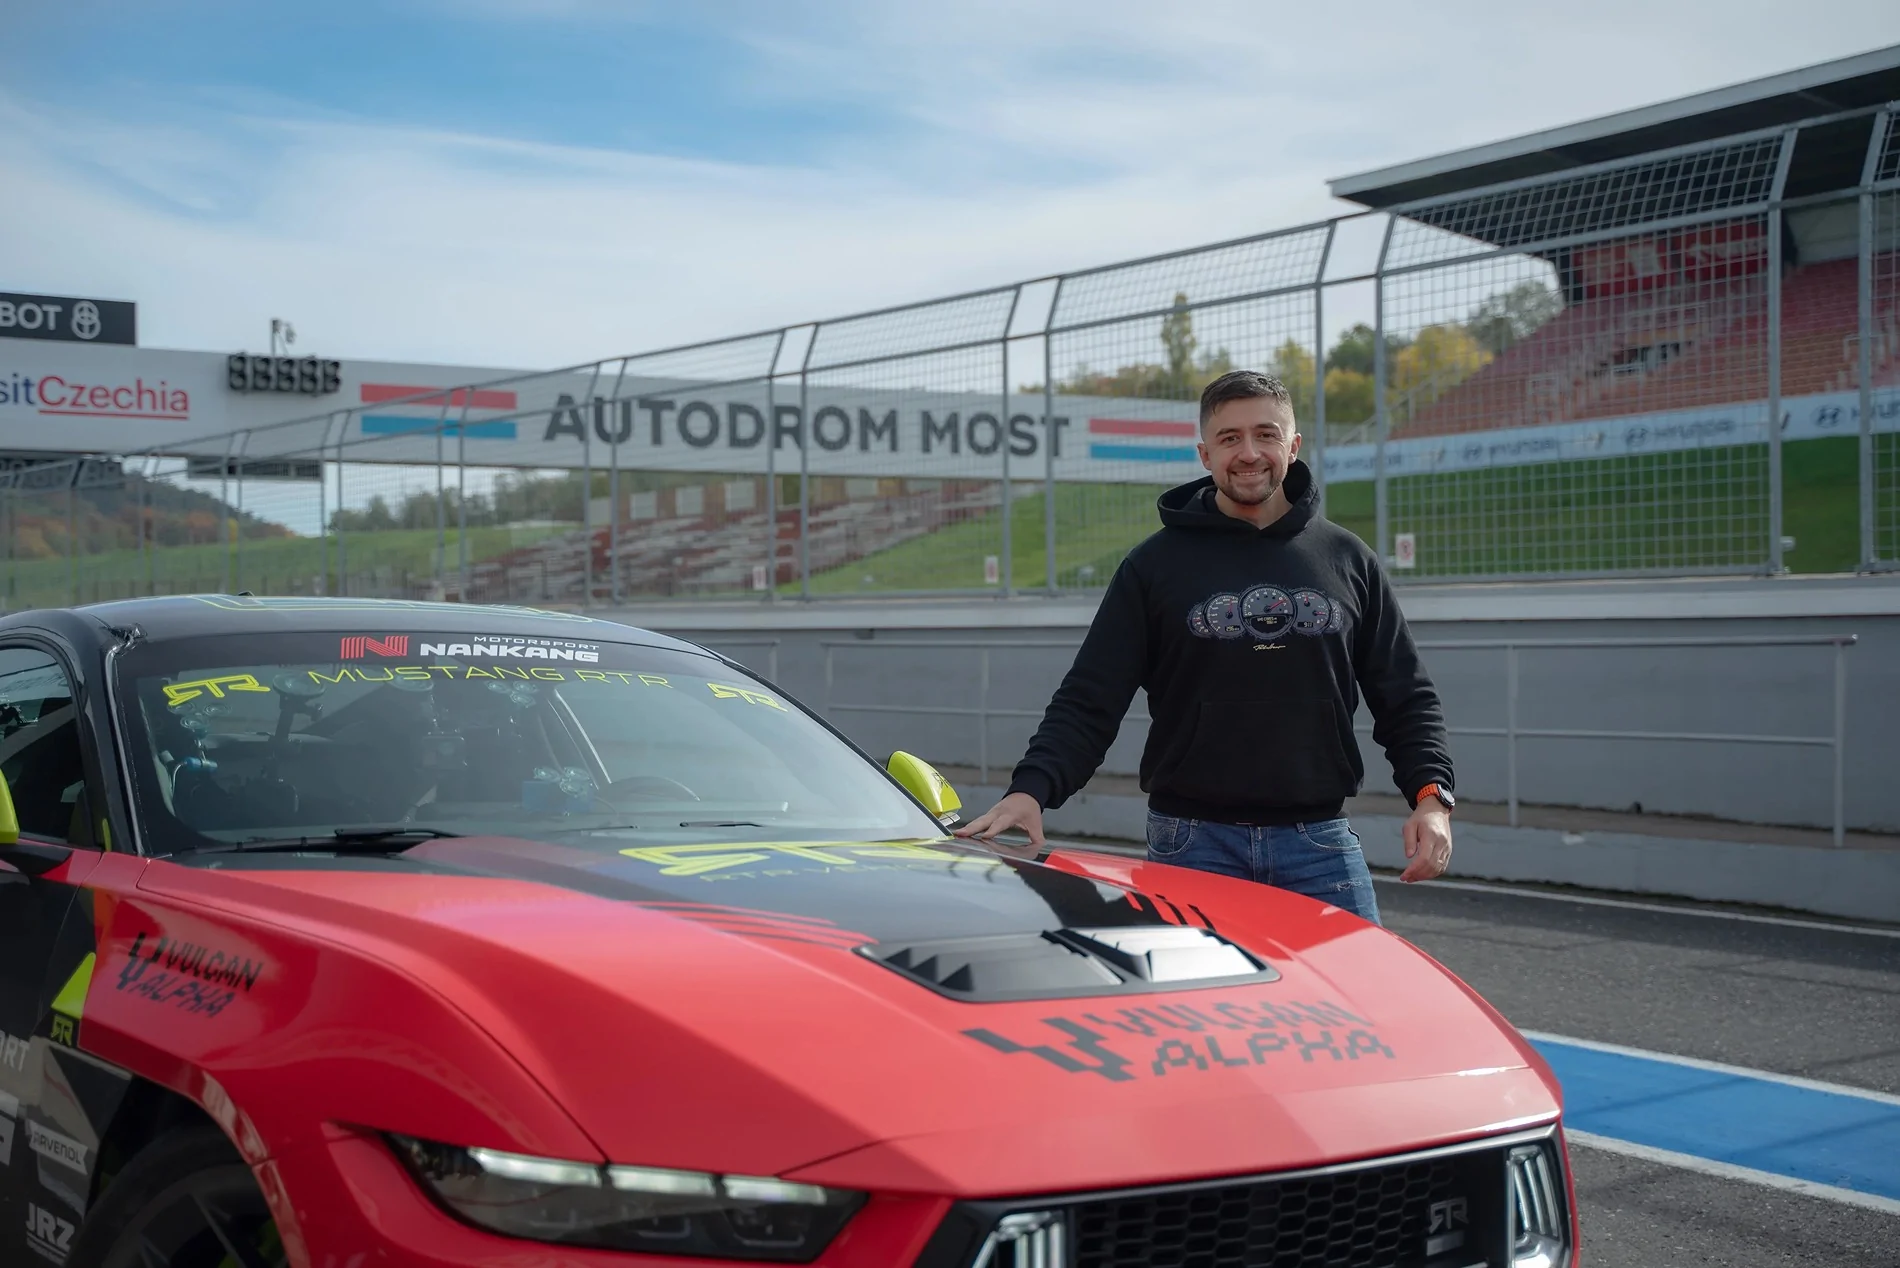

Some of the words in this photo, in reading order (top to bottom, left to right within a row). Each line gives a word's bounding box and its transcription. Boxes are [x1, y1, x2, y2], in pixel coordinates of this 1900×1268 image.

[543, 393, 898, 452] AUTODROM
[921, 410, 1070, 457] MOST
[420, 643, 599, 663] NANKANG
[474, 636, 600, 650] MOTORSPORT
[308, 666, 565, 683] MUSTANG
[575, 670, 674, 688] RTR
[165, 940, 264, 991] VULCAN
[127, 973, 235, 1018] ALPHA
[1082, 1000, 1374, 1037] VULCAN
[1151, 1030, 1396, 1076] ALPHA
[25, 1202, 76, 1252] JRZ
